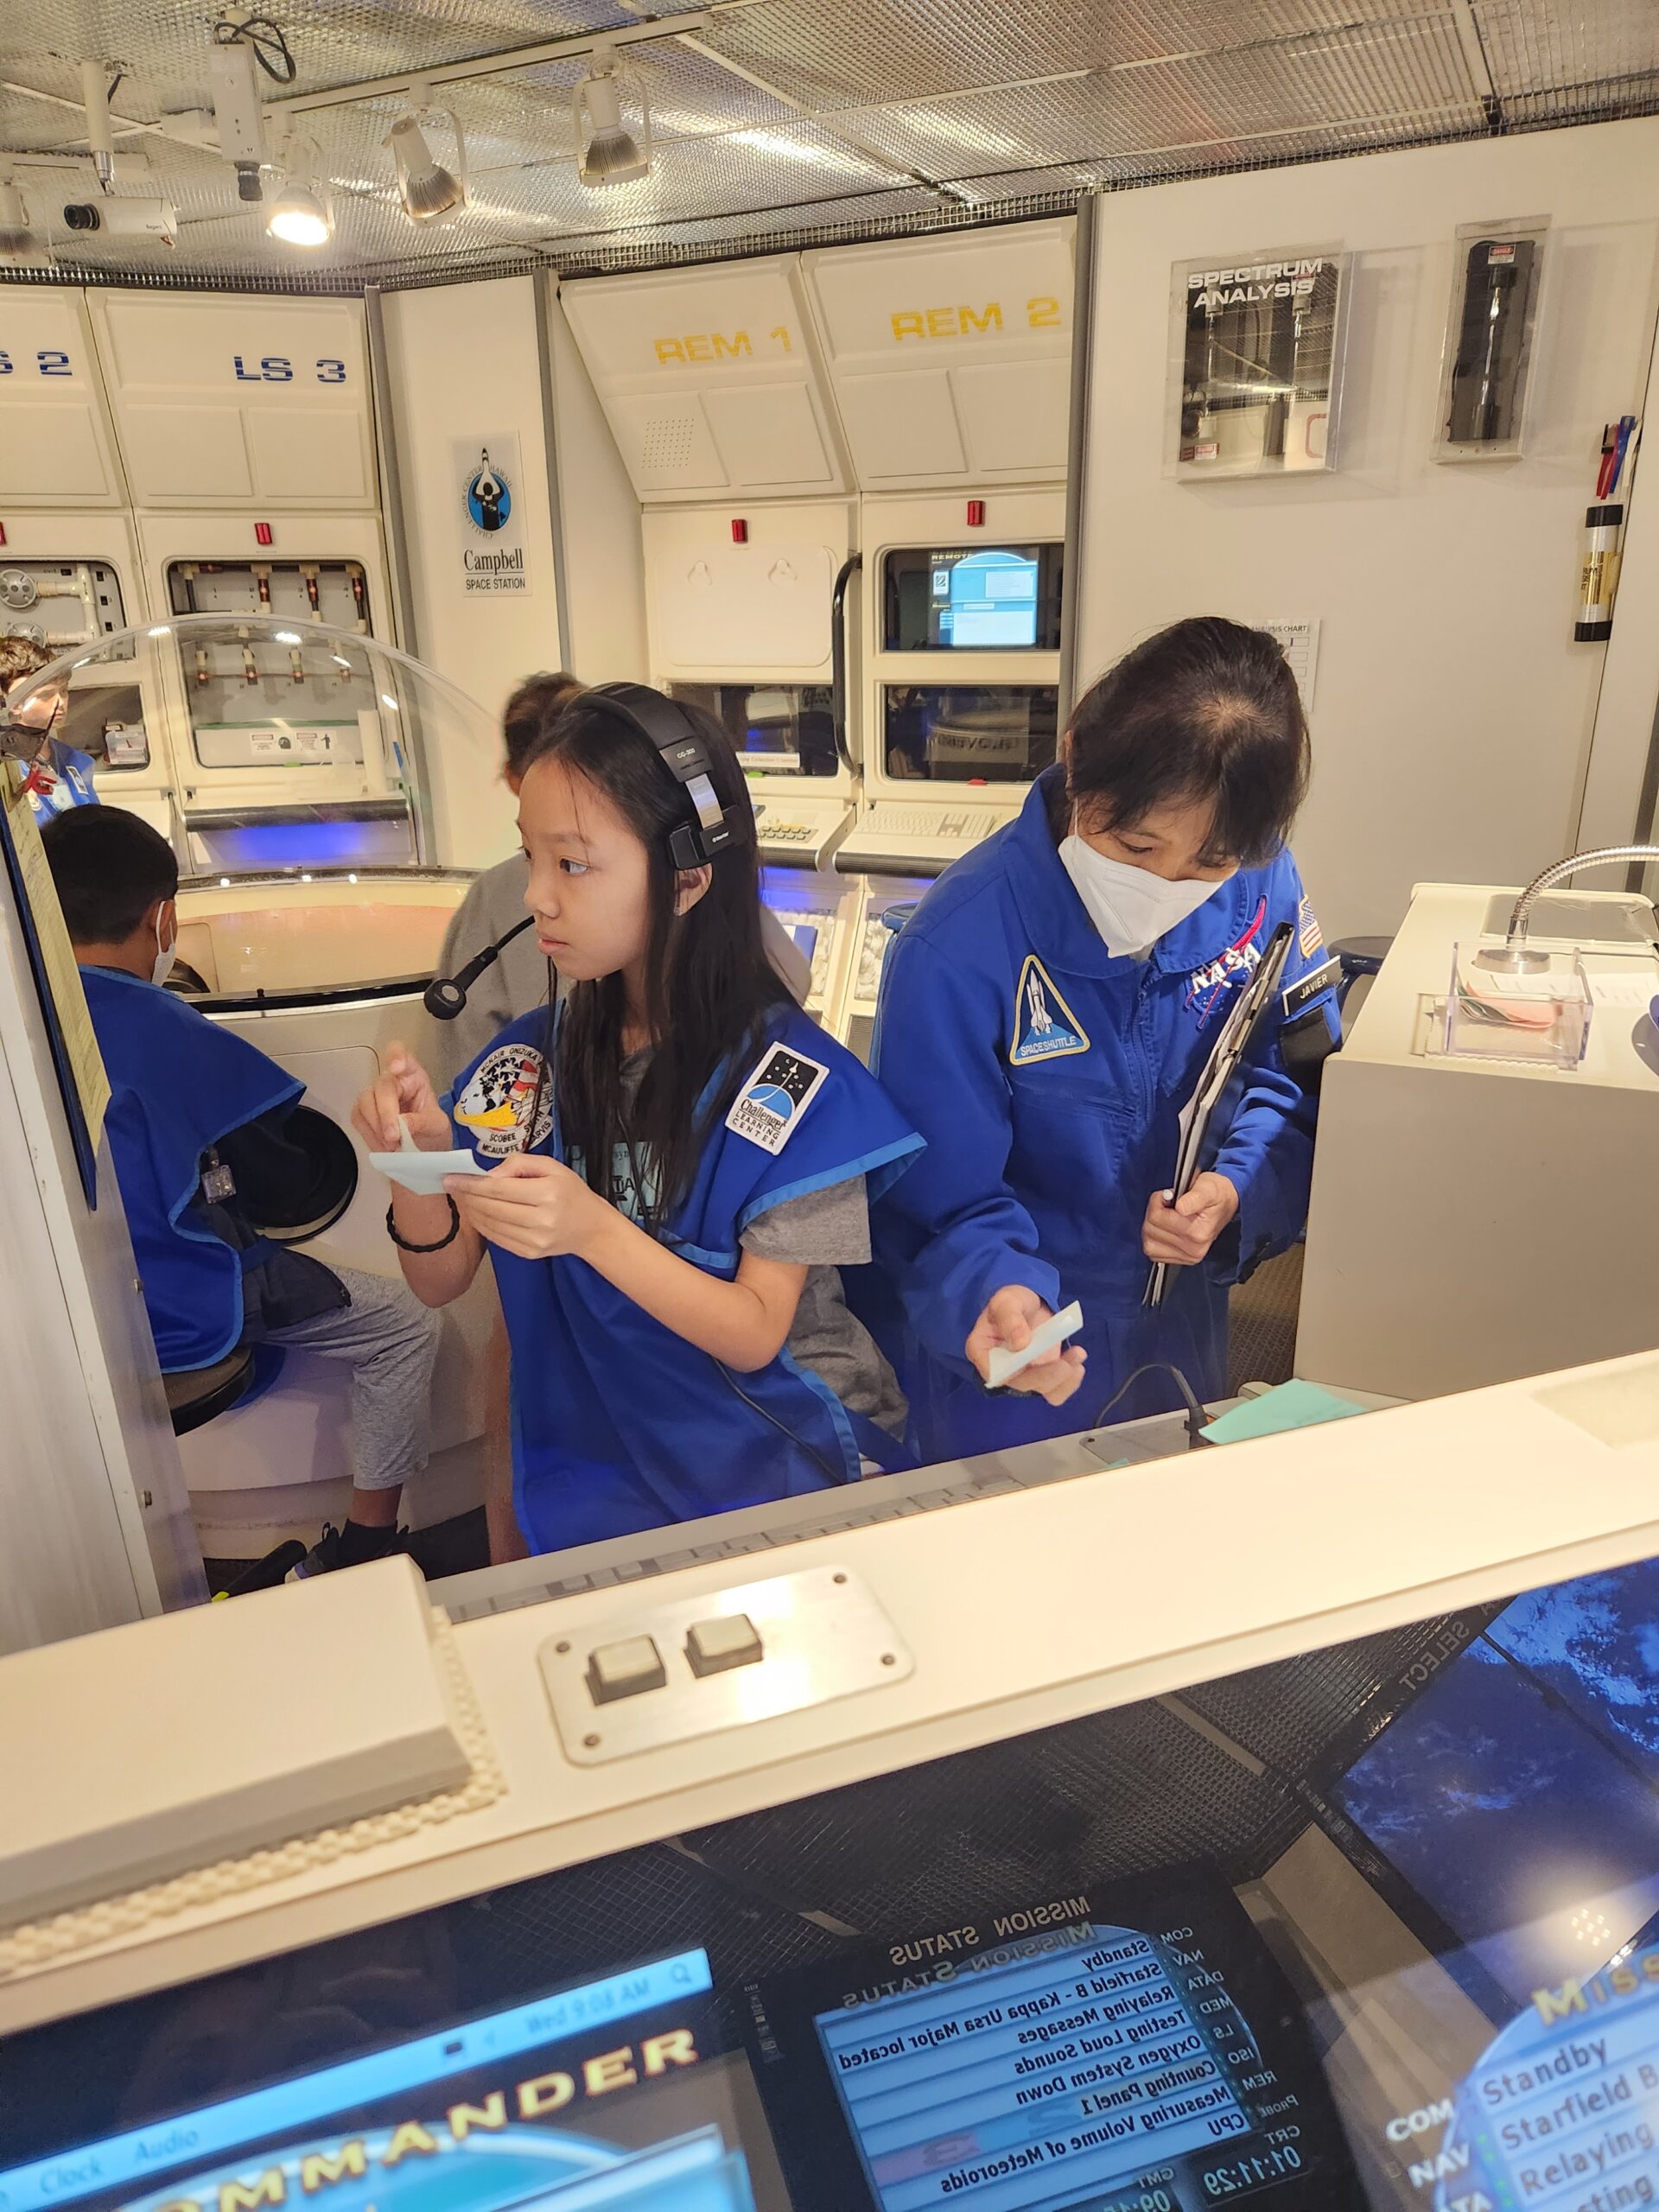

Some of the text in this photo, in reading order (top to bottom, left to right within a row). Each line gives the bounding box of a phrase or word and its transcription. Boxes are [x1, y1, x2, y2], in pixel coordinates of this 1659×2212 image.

[1188, 258, 1322, 289] SPECTRUM
[1193, 280, 1314, 308] ANALYSIS
[890, 296, 1062, 341] REM 2
[653, 326, 793, 365] REM 1
[37, 351, 73, 376] 2
[233, 356, 346, 383] LS 3
[463, 548, 524, 575] Campbell
[466, 577, 526, 591] SPACE STATION
[1190, 943, 1262, 994] NASA
[1300, 974, 1329, 1000] JAVIER
[480, 1050, 505, 1073] MCNAIR
[509, 1047, 538, 1062] ONIZUKA
[735, 1110, 780, 1140] LEARNING
[741, 1098, 784, 1131] Challenger
[489, 1132, 518, 1143] SCOBEE
[732, 1118, 776, 1147] CENTER
[481, 1143, 520, 1154] MCAULIFFE
[1482, 2038, 1609, 2105] Standby
[1385, 2098, 1456, 2142] COM
[1501, 2063, 1659, 2150] Starfield B
[38, 2128, 200, 2195] Clock Audio
[1408, 2143, 1469, 2189] NAV
[1519, 2122, 1655, 2196] Relaying
